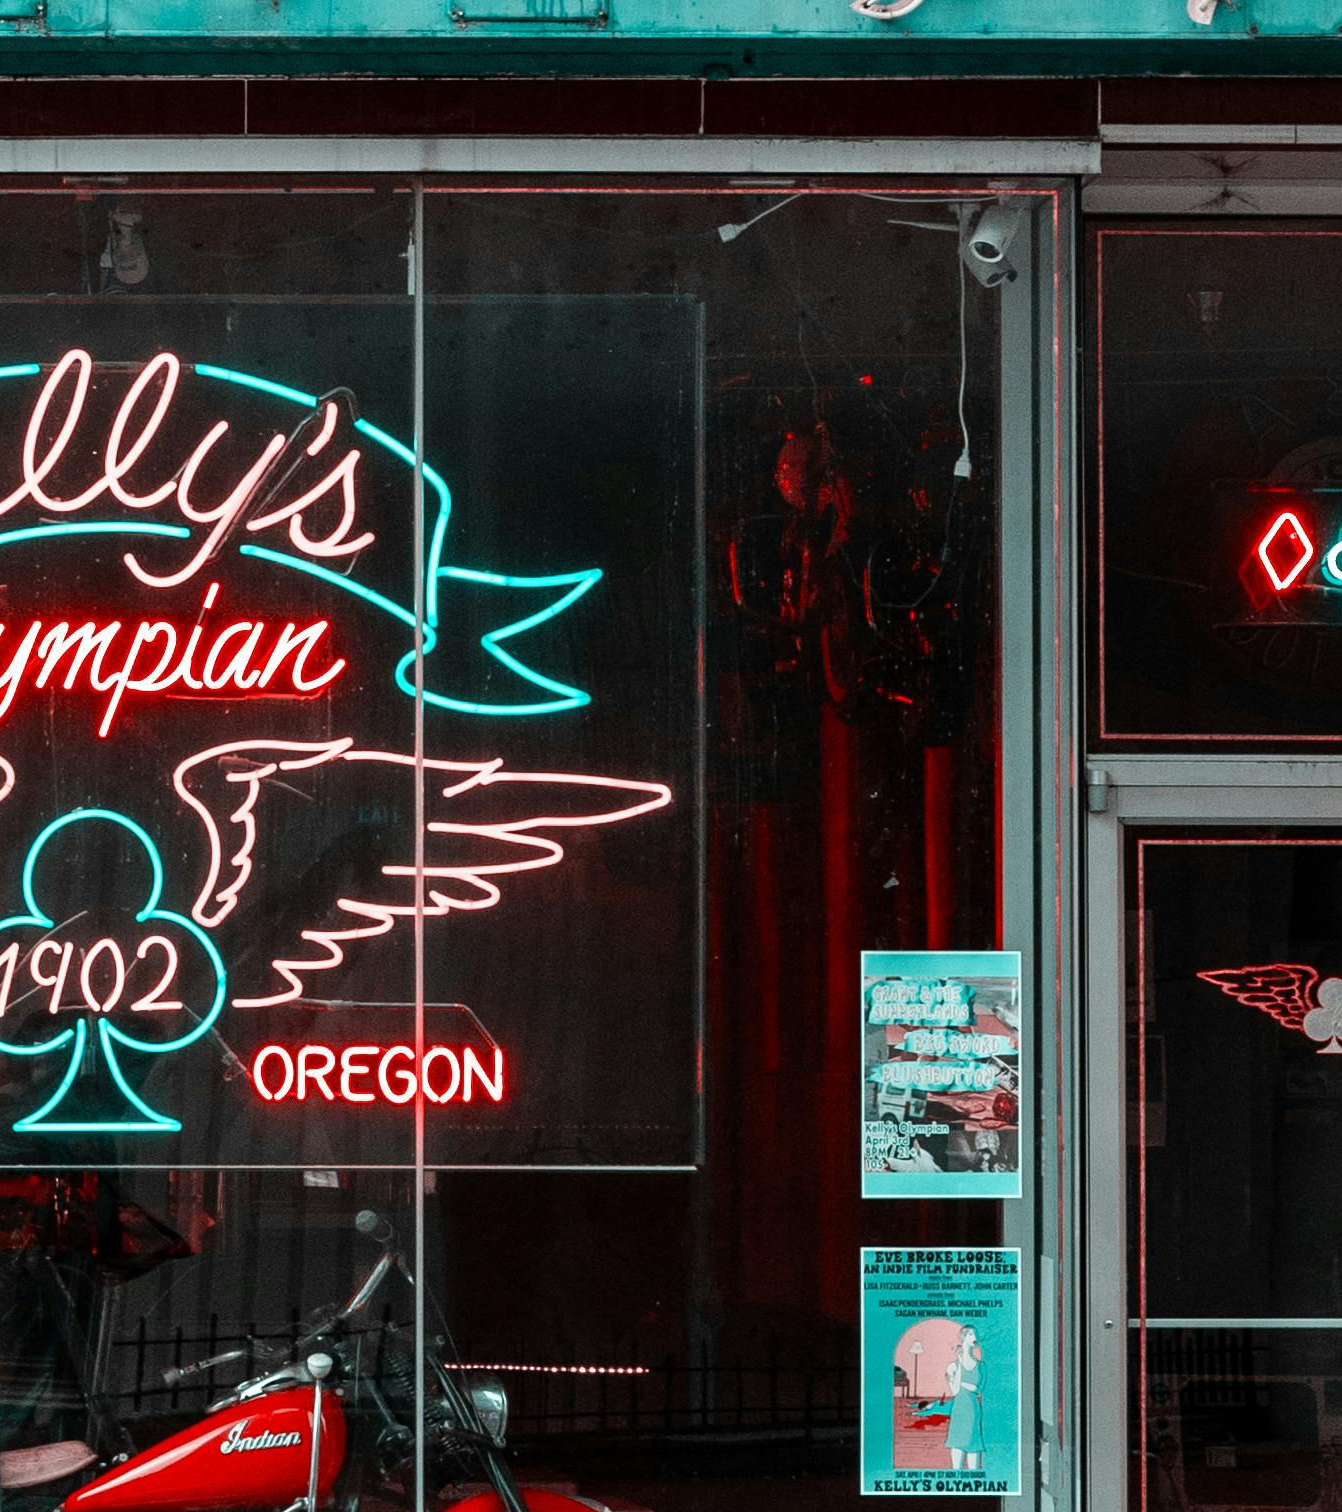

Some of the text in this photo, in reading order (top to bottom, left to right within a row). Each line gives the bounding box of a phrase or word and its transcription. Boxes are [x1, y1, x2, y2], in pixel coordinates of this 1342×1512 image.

[251, 1044, 505, 1104] OREGON
[899, 1122, 949, 1136] Olympian
[865, 1136, 909, 1146] April 3rd
[874, 1251, 903, 1263] EVE
[906, 1251, 954, 1263] BROKE
[864, 1264, 1019, 1274] AN INDIE FILM FUNDRAISER
[220, 1419, 301, 1454] Indian
[874, 1480, 1008, 1492] KELLY'S OLYMPIAN
